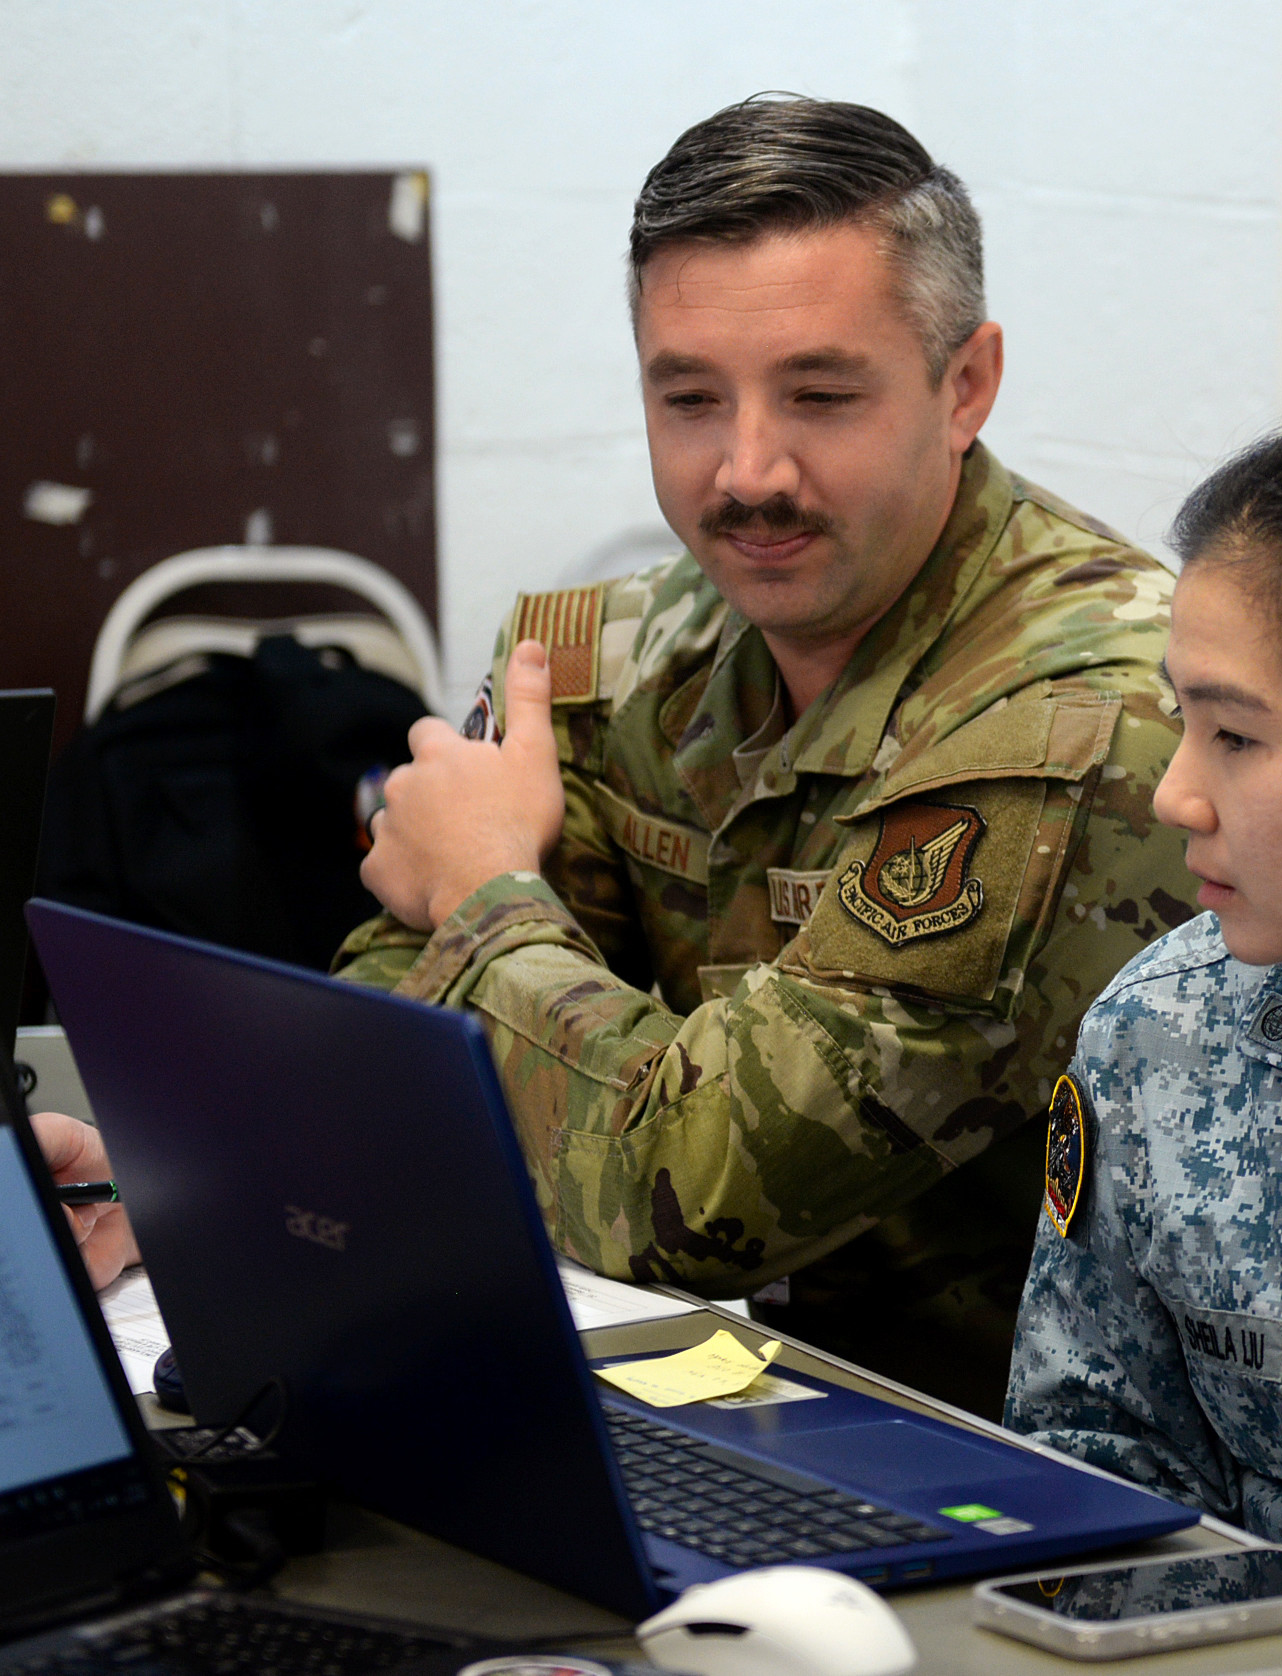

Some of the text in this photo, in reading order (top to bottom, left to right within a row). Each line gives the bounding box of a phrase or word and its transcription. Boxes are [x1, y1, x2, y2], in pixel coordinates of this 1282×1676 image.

[622, 814, 691, 872] ALLEN
[844, 884, 885, 925] PACIFIC
[881, 922, 908, 940] AIR
[913, 902, 970, 933] FORCES
[284, 1205, 352, 1252] acer
[1184, 1313, 1238, 1363] SHEILA
[1241, 1329, 1265, 1370] LIU
